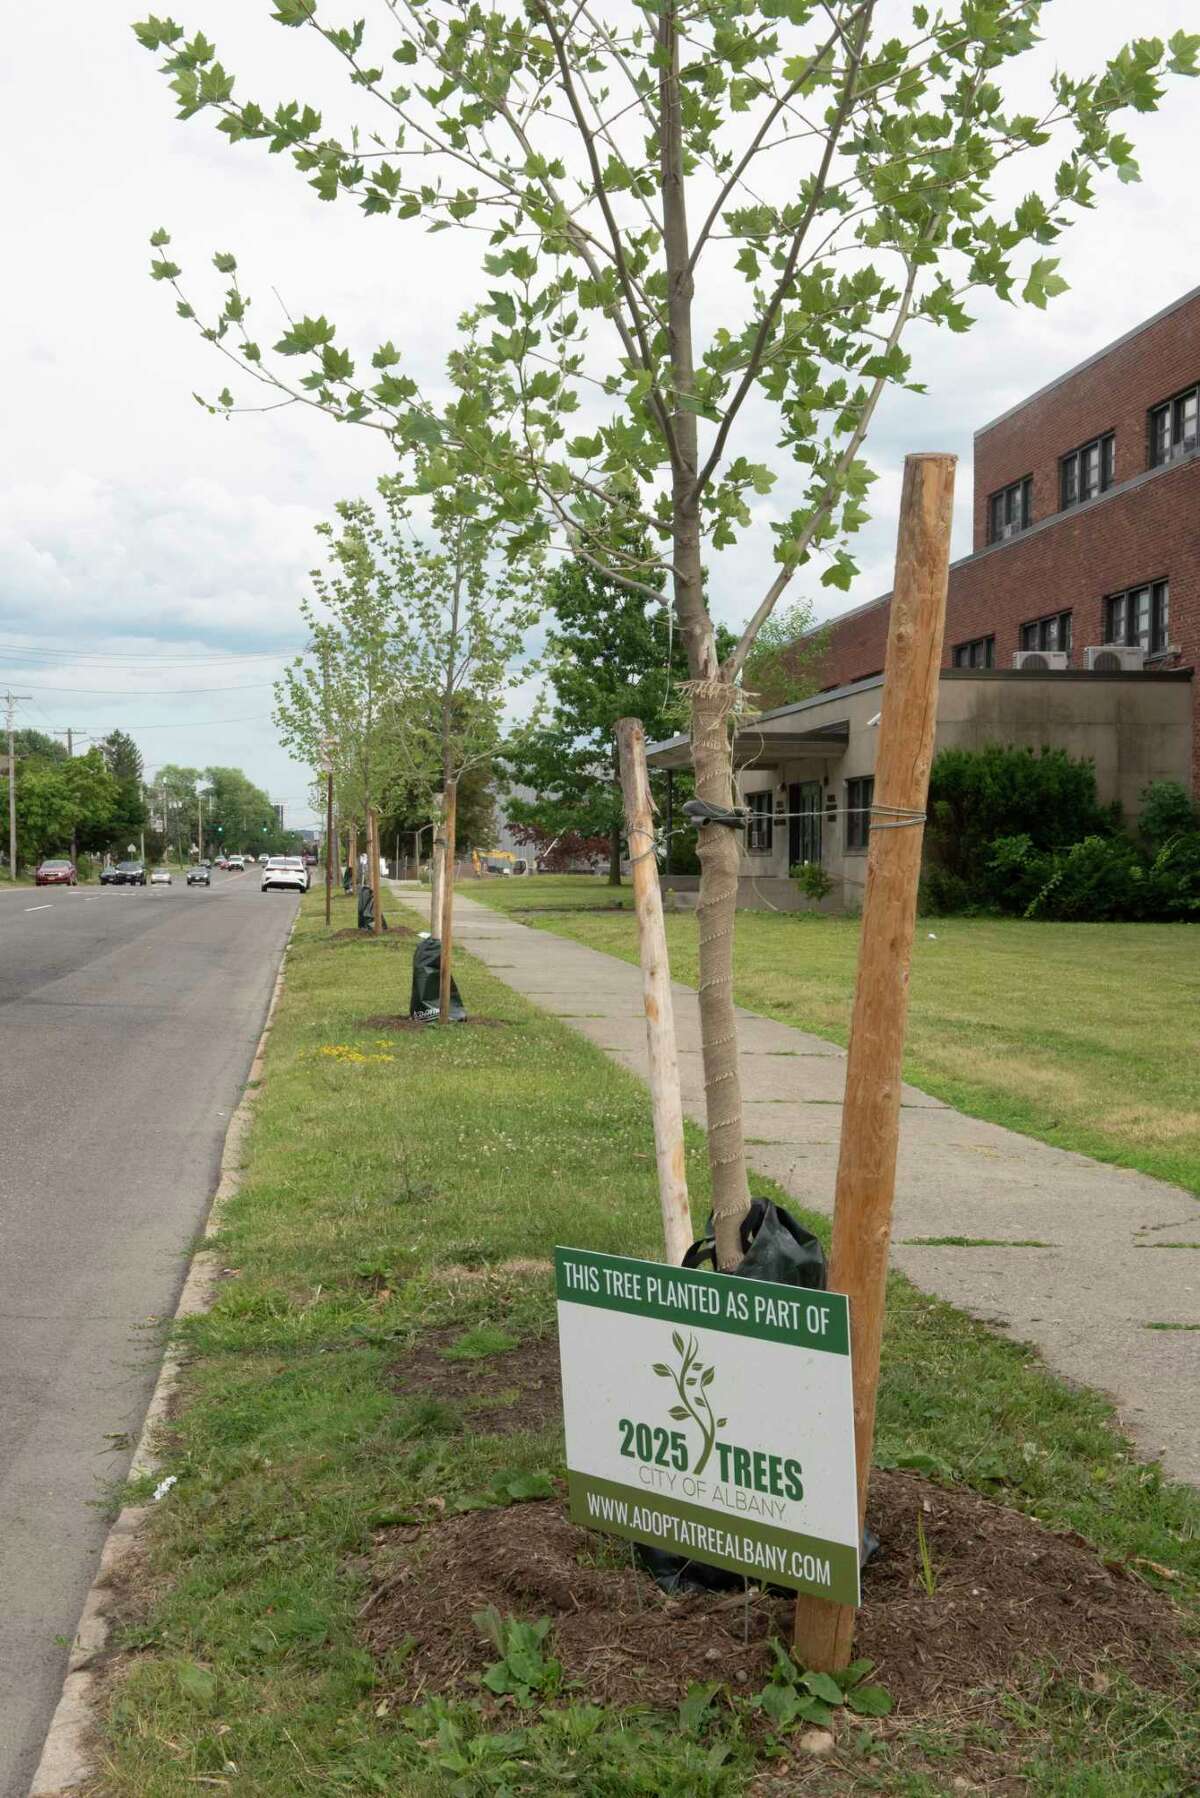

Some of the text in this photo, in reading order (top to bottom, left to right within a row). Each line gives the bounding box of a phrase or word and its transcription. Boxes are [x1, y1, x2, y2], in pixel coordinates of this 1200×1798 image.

[563, 1262, 830, 1336] THIS TREE PLANTED AS PART OF
[618, 1418, 804, 1501] 2025 TREES
[638, 1465, 787, 1521] CITY OF ALBANY
[586, 1492, 832, 1586] WWW.ADOPTATREEALBANY.COM
